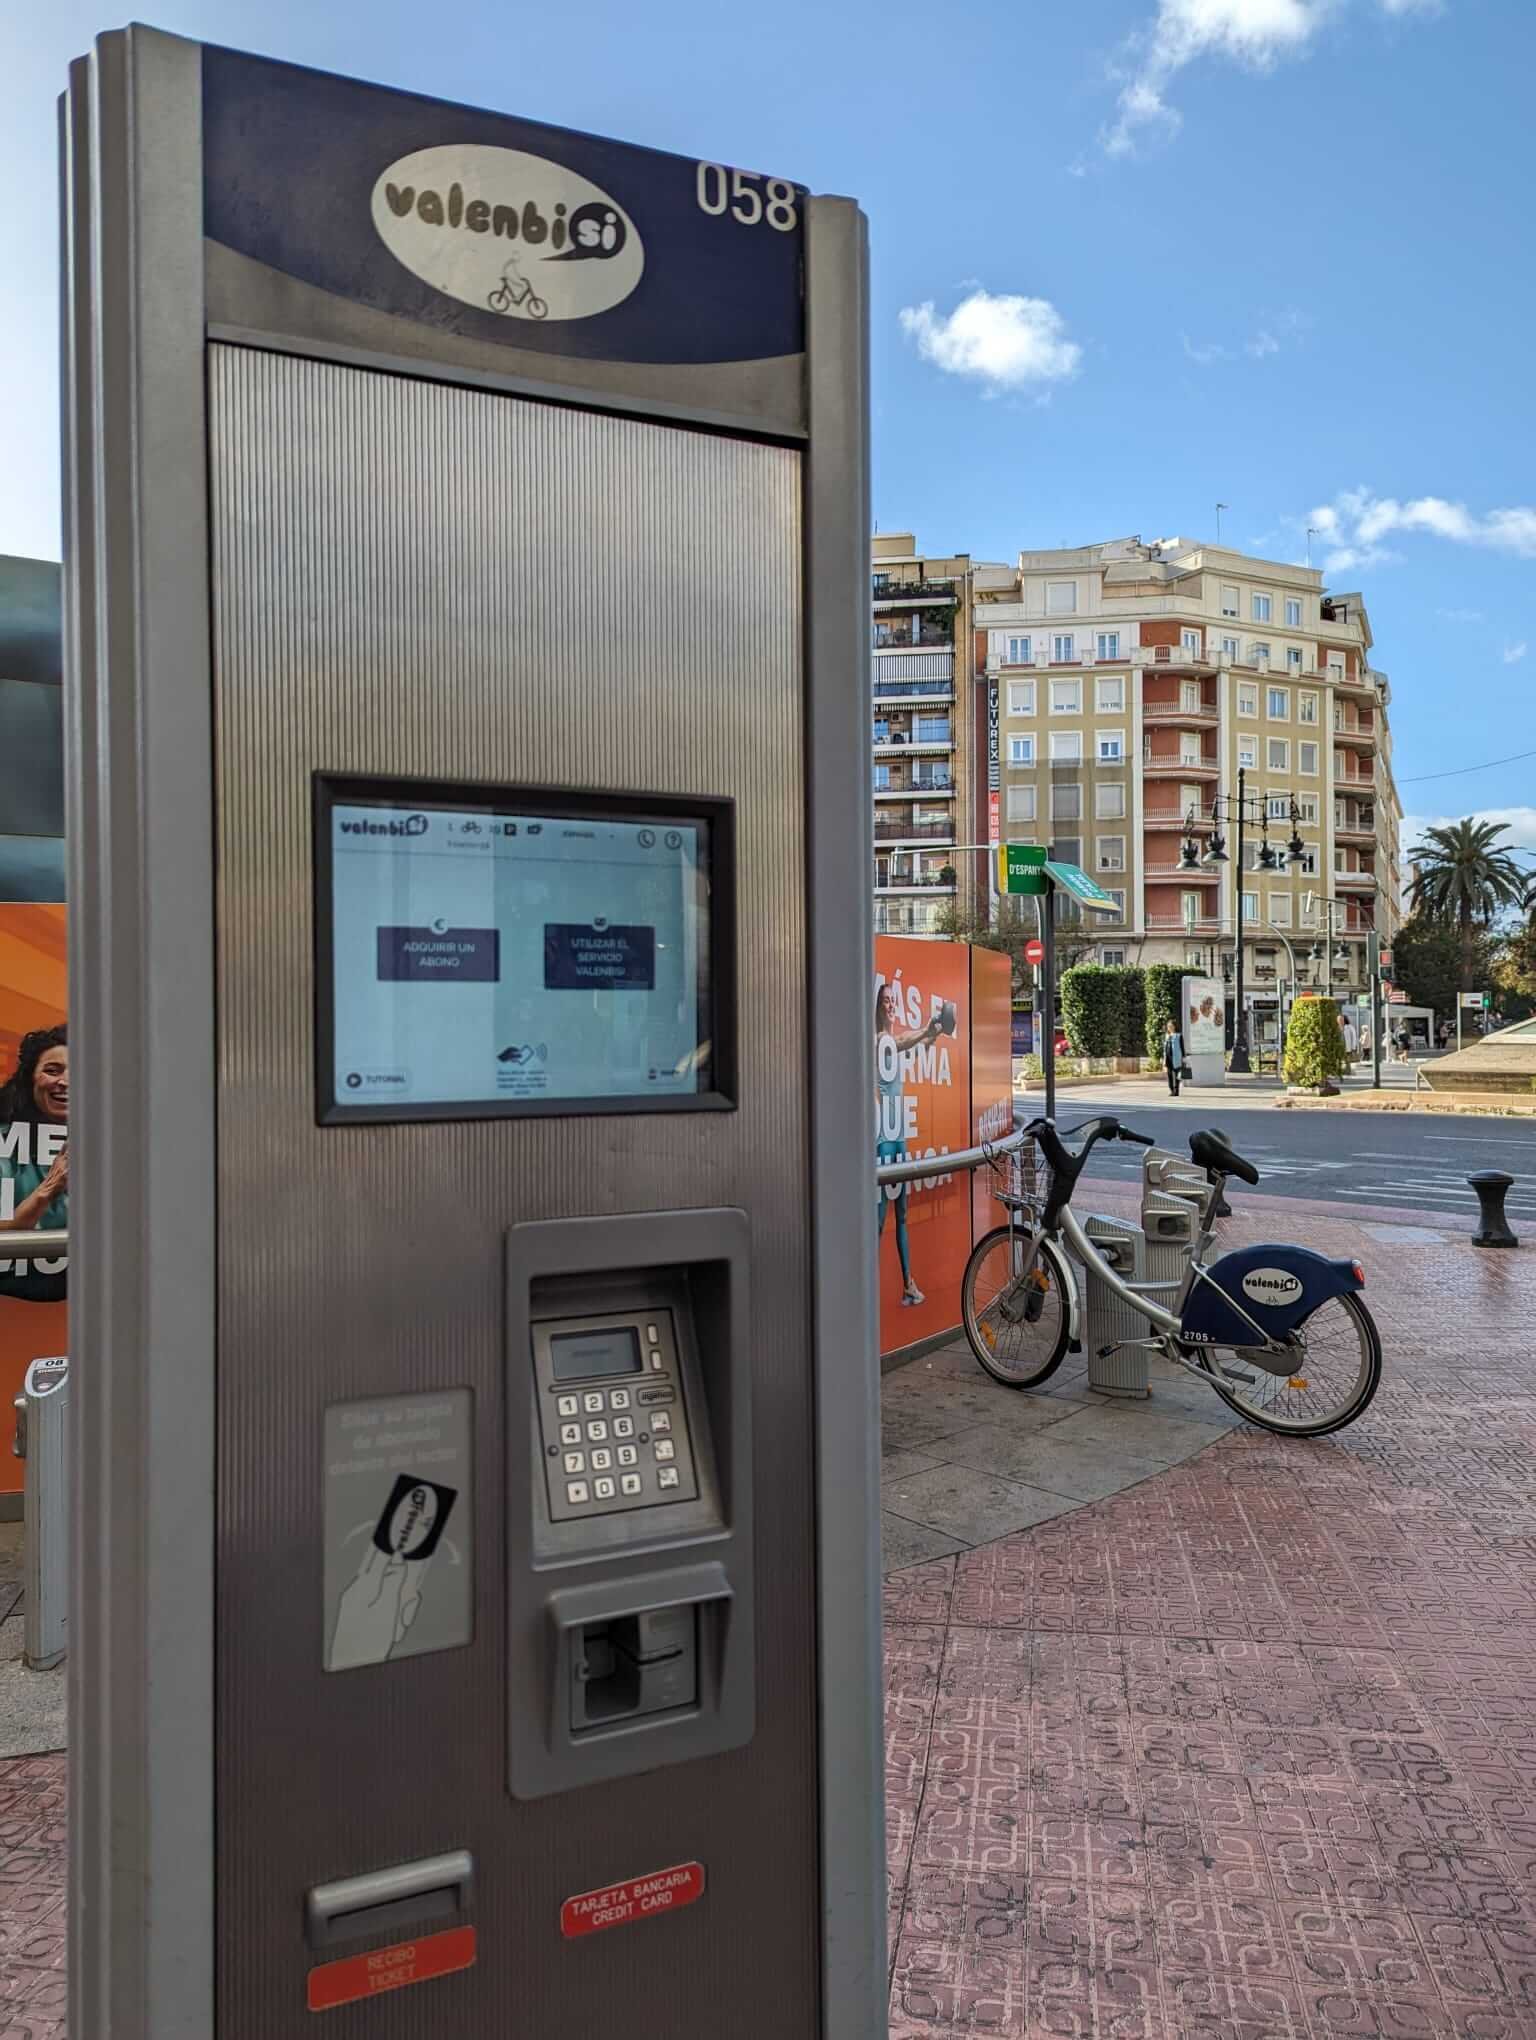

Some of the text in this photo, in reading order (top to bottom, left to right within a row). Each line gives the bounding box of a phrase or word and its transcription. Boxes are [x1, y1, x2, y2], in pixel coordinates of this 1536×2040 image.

[697, 160, 797, 231] 058
[384, 181, 626, 258] valenbisi
[990, 688, 999, 759] FUTUREX
[403, 942, 475, 953] ADQUIRIR UN
[419, 956, 460, 967] ABONO
[873, 968, 957, 1040] ÁS E
[875, 1095, 918, 1142] UE
[1184, 1330, 1208, 1342] 2705
[572, 1871, 692, 1916] TARJETA BANCARIA
[592, 1890, 673, 1925] CREDIT CARD
[367, 1945, 416, 1971] RECIBO
[367, 1963, 416, 1990] TICKET
